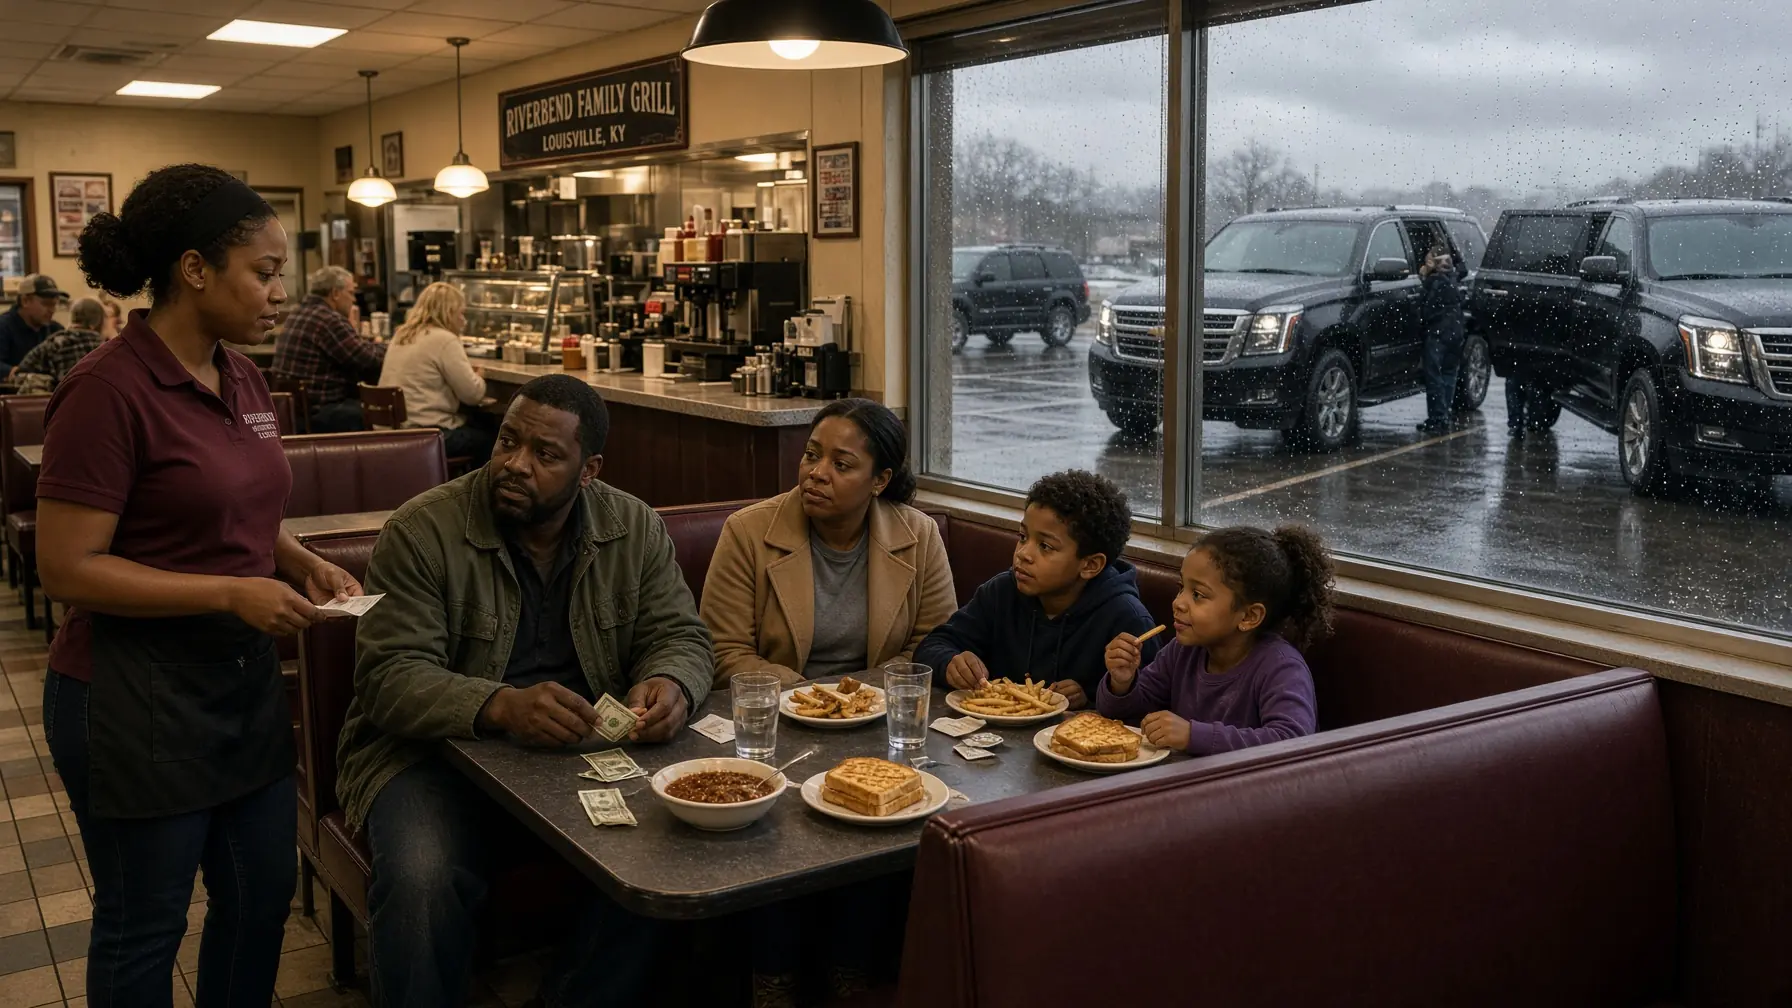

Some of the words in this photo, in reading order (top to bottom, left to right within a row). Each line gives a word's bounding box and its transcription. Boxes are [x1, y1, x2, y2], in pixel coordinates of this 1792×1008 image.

[507, 93, 573, 137] RIVERBEND
[578, 83, 626, 118] FAMILY
[631, 82, 675, 115] GRILL
[543, 128, 606, 151] LOUISVILLE,
[610, 124, 626, 142] KY
